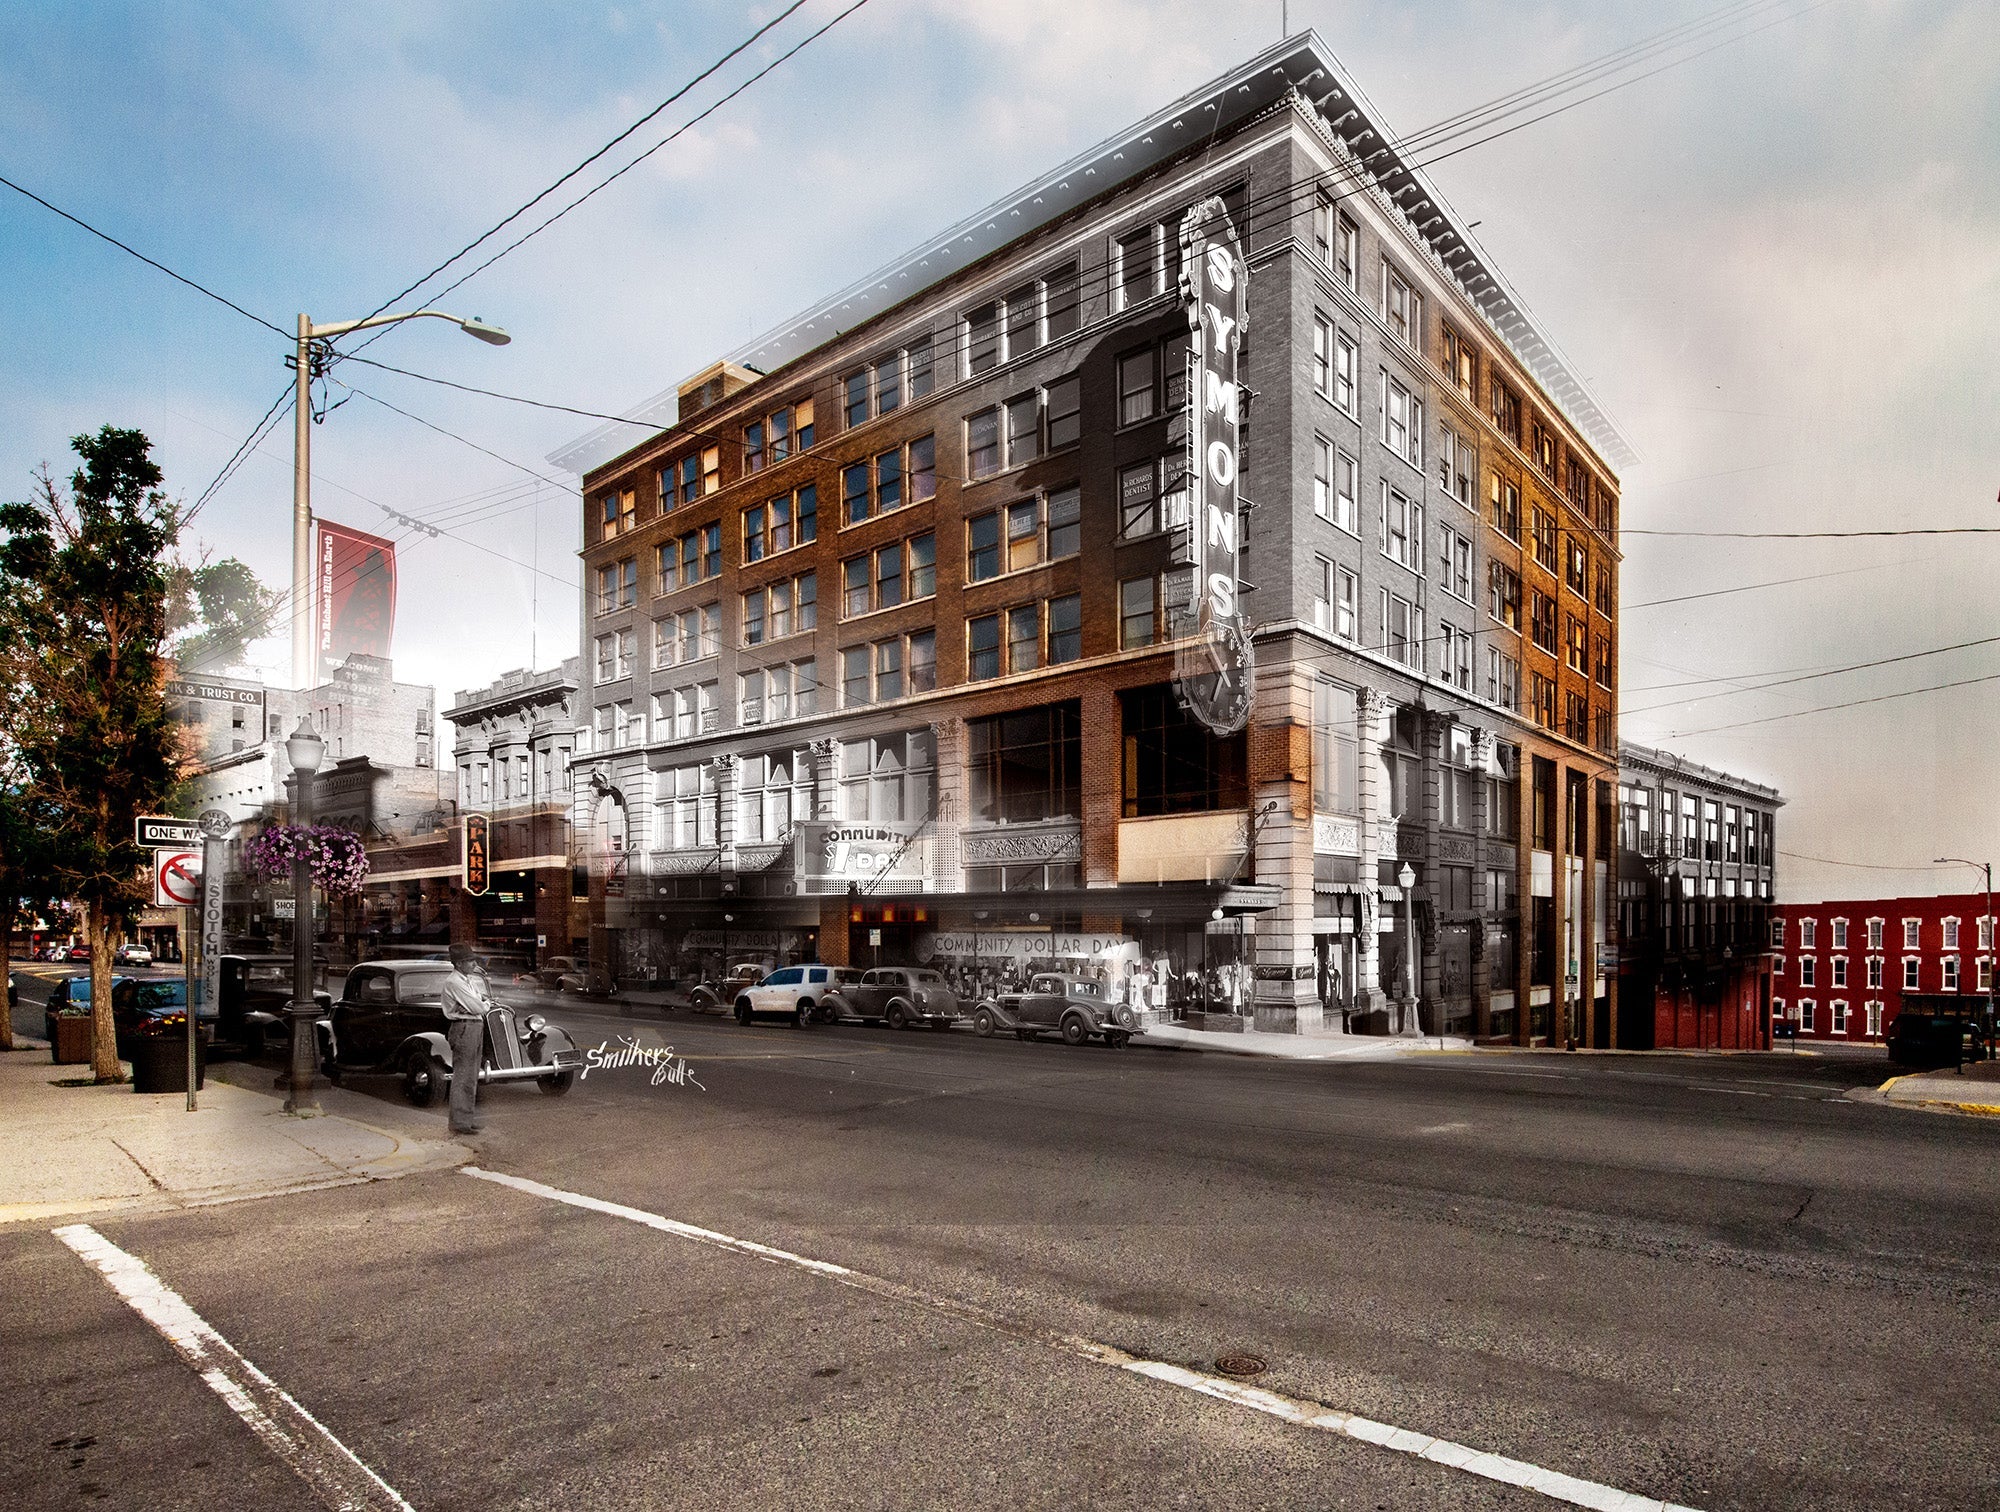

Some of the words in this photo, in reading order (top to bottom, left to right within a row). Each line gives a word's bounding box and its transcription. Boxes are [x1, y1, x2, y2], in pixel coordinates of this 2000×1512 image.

[1205, 242, 1235, 618] SYMONS
[1124, 482, 1151, 498] DENTIST
[324, 535, 333, 563] Earth
[324, 563, 333, 575] on
[323, 576, 332, 593] Hill
[322, 594, 332, 630] Richest
[322, 631, 331, 651] The
[186, 685, 195, 695] &
[200, 687, 236, 700] TRUST
[239, 692, 257, 703] CO.
[149, 827, 178, 838] ONE
[183, 829, 200, 839] WA
[468, 827, 485, 883] PARK
[205, 885, 220, 955] SCOTCH
[690, 933, 739, 946] COMMUITY
[746, 934, 778, 946] DOLLA
[934, 937, 1014, 953] COMMUNITY
[1024, 938, 1081, 953] DOLLAR
[1092, 939, 1126, 954] DAY
